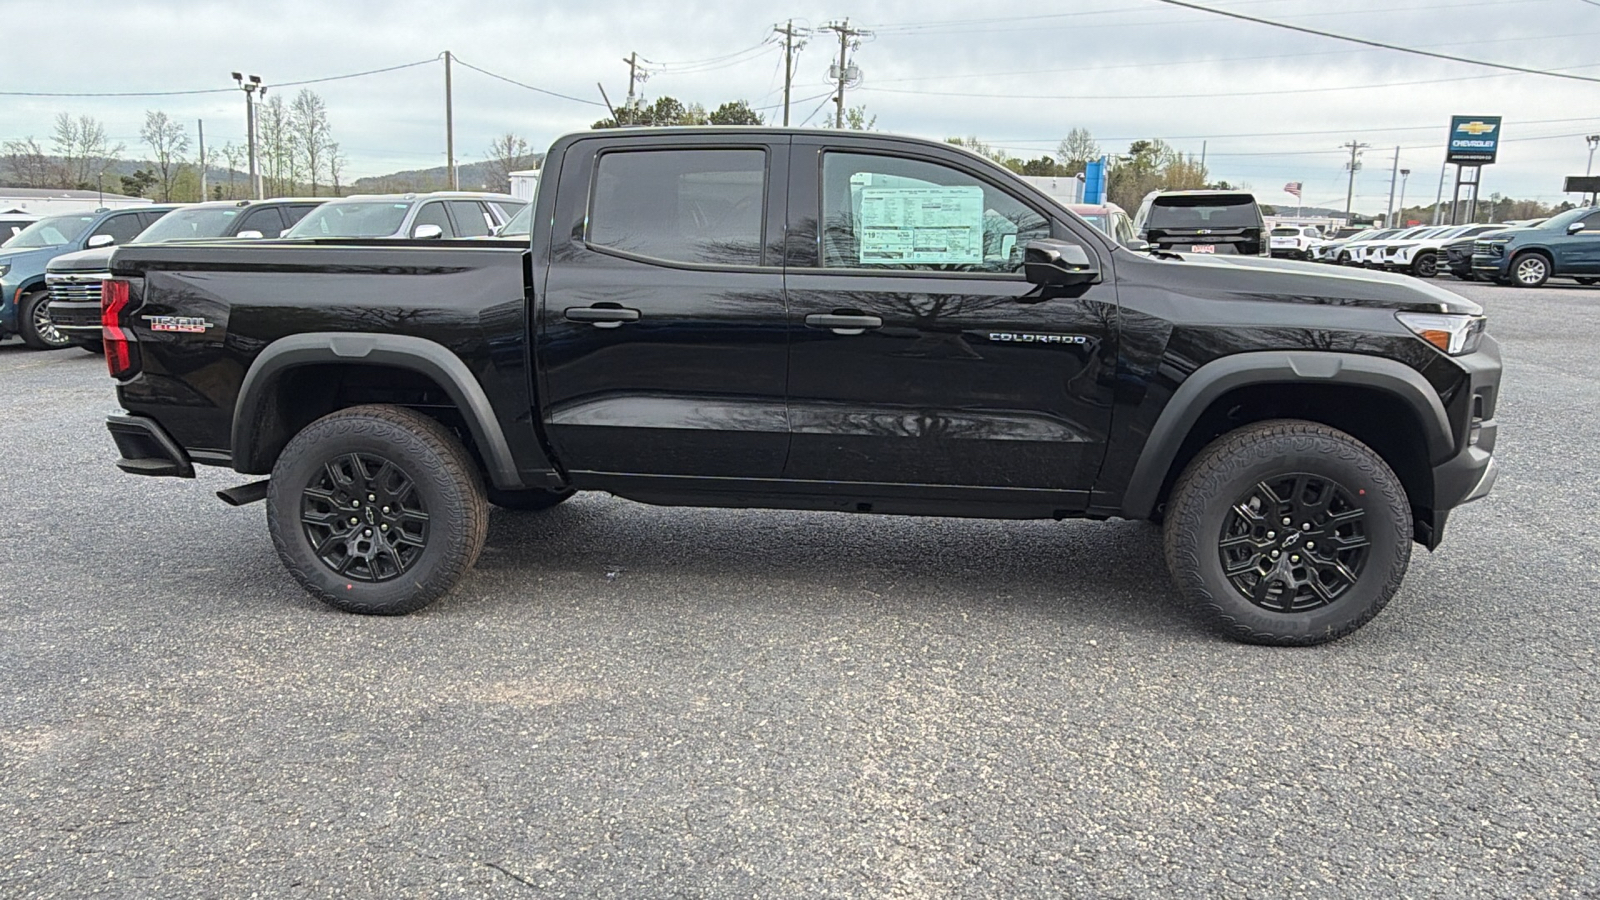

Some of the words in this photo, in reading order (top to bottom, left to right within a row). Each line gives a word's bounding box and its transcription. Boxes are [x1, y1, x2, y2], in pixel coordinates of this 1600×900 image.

[1452, 140, 1494, 148] CHEVROLET
[141, 315, 213, 327] TRAIL
[151, 324, 206, 333] BOSS
[989, 333, 1086, 344] COLORADO
